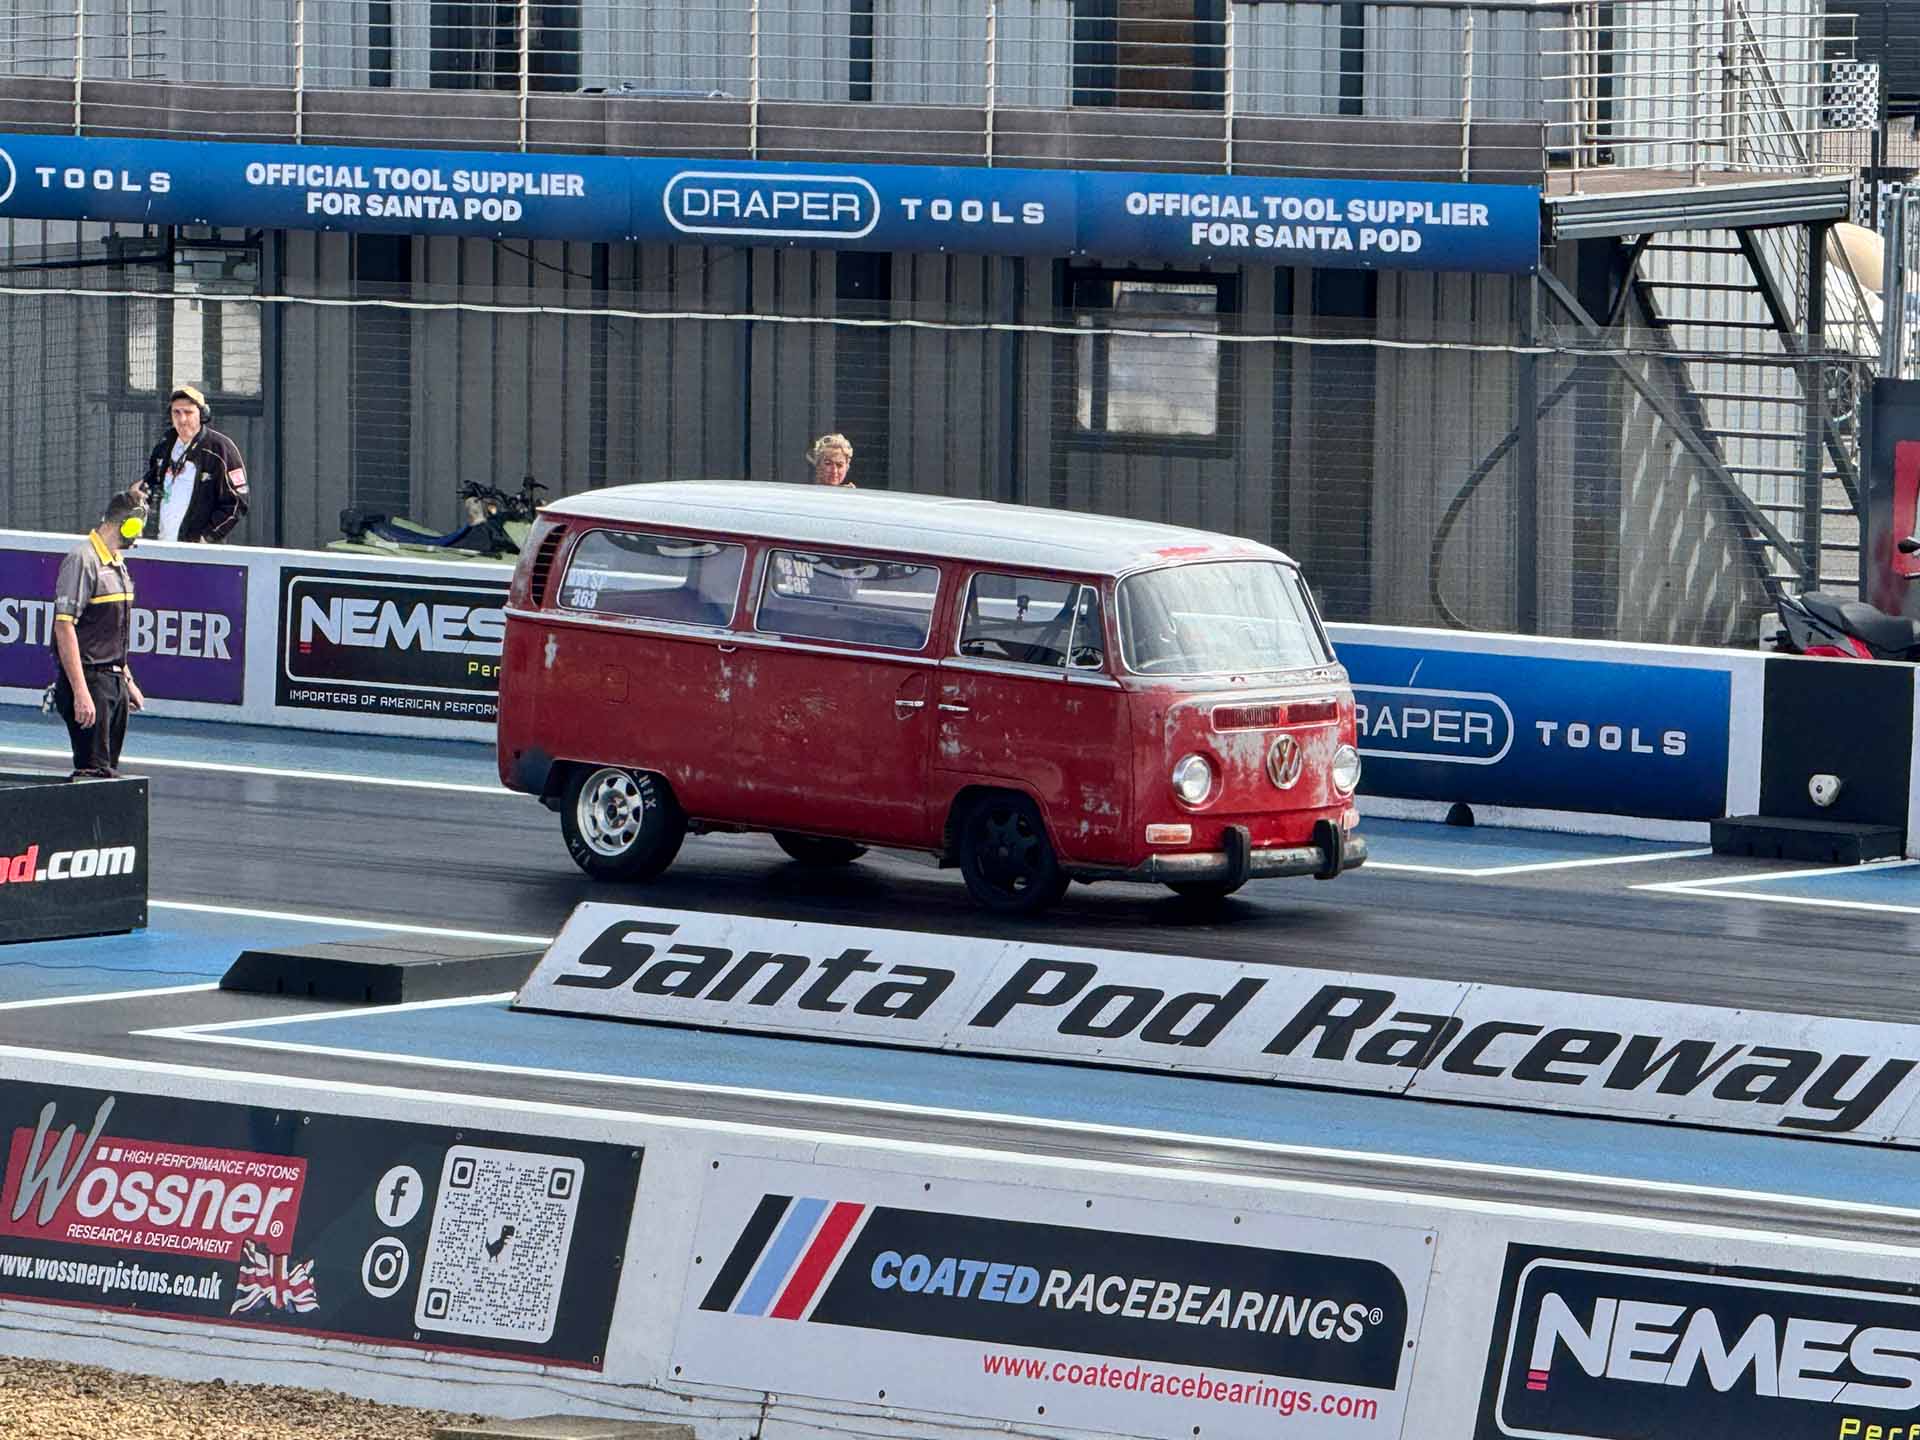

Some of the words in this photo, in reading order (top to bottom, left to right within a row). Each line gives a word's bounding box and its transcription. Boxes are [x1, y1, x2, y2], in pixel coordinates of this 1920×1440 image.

[36, 168, 170, 192] TOOLS
[246, 163, 369, 188] OFFICIAL
[373, 168, 447, 191] TOOL
[453, 170, 584, 196] SUPPLIER
[308, 192, 360, 215] FOR
[366, 194, 458, 219] SANTA
[464, 198, 522, 221] POD
[684, 188, 859, 221] DRAPER
[901, 199, 1044, 224] TOOLS
[1126, 192, 1258, 218] OFFICIAL
[1264, 197, 1342, 221] TOOL
[1347, 200, 1488, 225] SUPPLIER
[1192, 223, 1249, 246] FOR
[1255, 225, 1353, 250] SANTA
[1360, 228, 1421, 252] POD
[130, 607, 231, 660] BEER
[301, 594, 507, 656] NEMES
[290, 690, 357, 704] IMPORTERS
[361, 696, 376, 705] OF
[380, 697, 440, 711] AMERICAN
[1536, 721, 1686, 755] TOOLS
[554, 920, 955, 1019] Santa
[968, 958, 1269, 1047] Pod
[1262, 985, 1918, 1131] Raceway
[123, 1150, 153, 1164] HIGH
[155, 1153, 245, 1175] PERFORMANCE
[246, 1163, 300, 1180] PISTONS
[67, 1223, 132, 1243] RESEARCH
[134, 1231, 142, 1244] &
[144, 1232, 232, 1254] DEVELOPMENT
[0, 1254, 221, 1299] ww.wossnerpistons.co.uk
[1529, 1292, 1920, 1411] NEMES
[983, 1354, 1377, 1421] www.coatedracebearings.com
